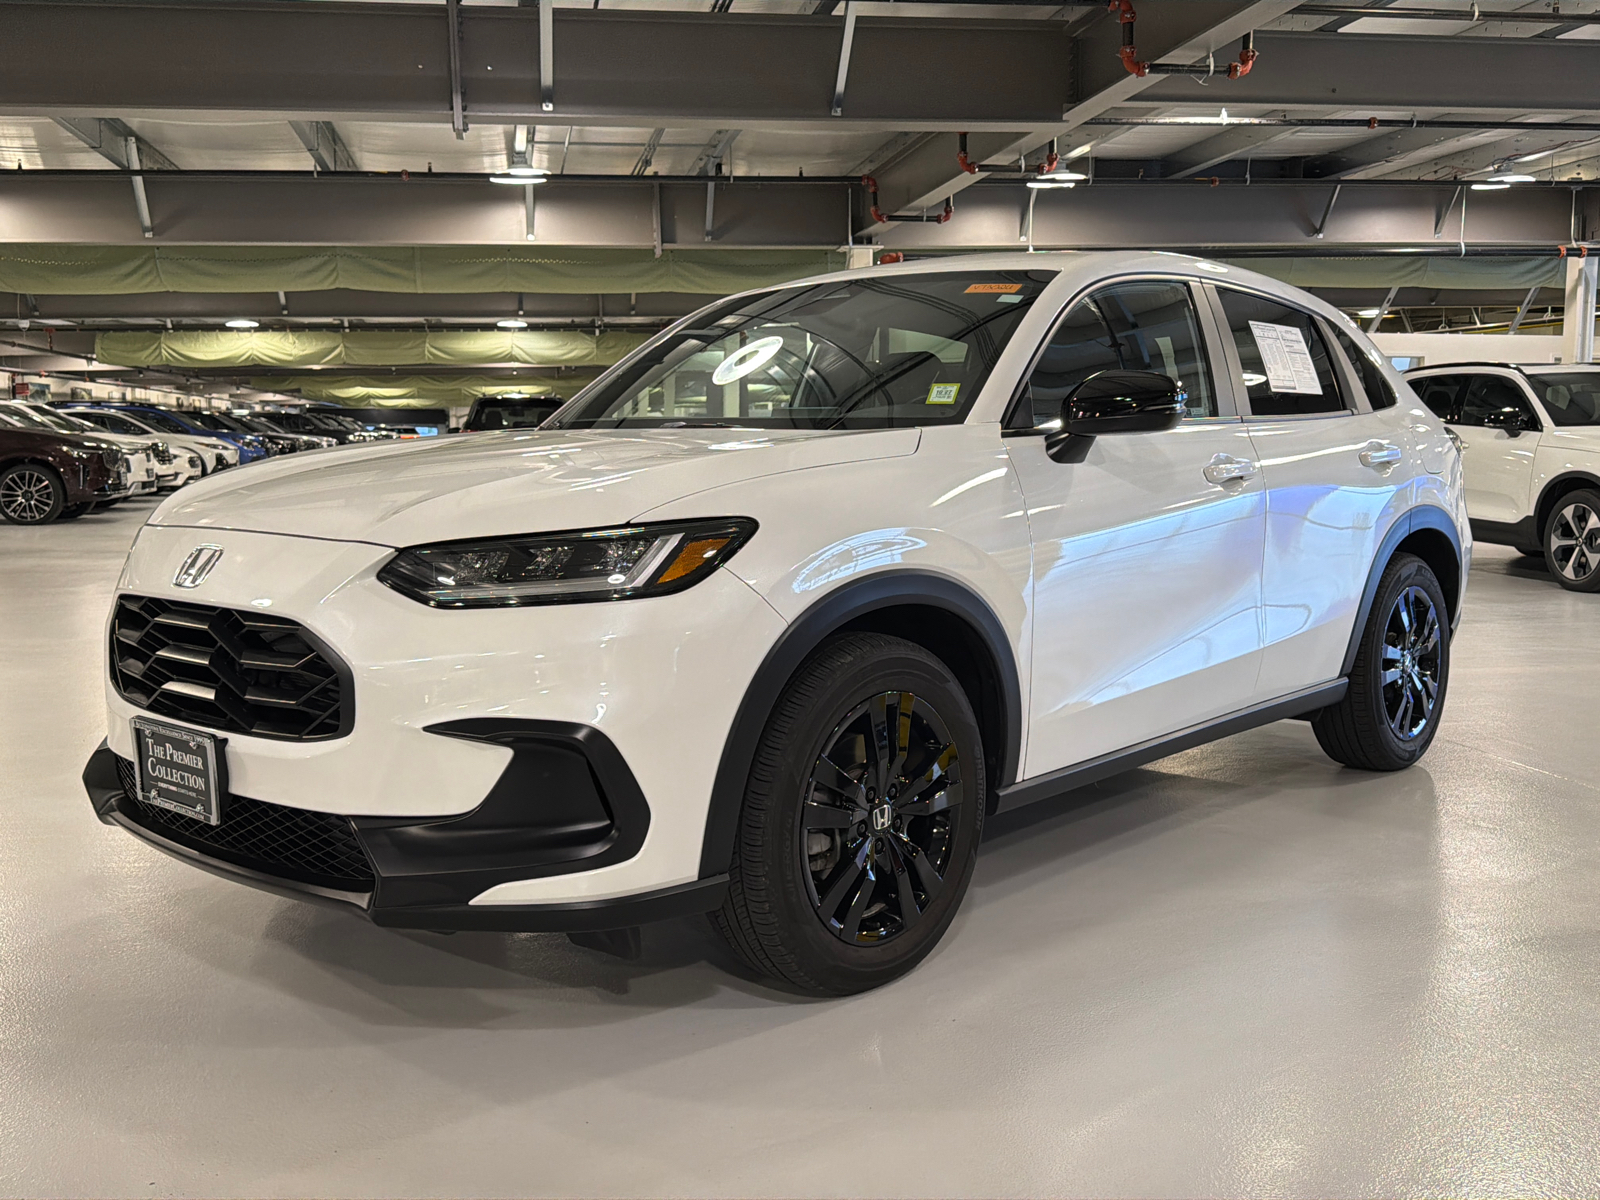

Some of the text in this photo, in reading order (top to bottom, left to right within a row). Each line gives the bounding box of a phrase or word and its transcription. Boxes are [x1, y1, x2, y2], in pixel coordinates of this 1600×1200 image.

[146, 738, 204, 770] THE PREMIER
[147, 757, 205, 791] COLLECTION
